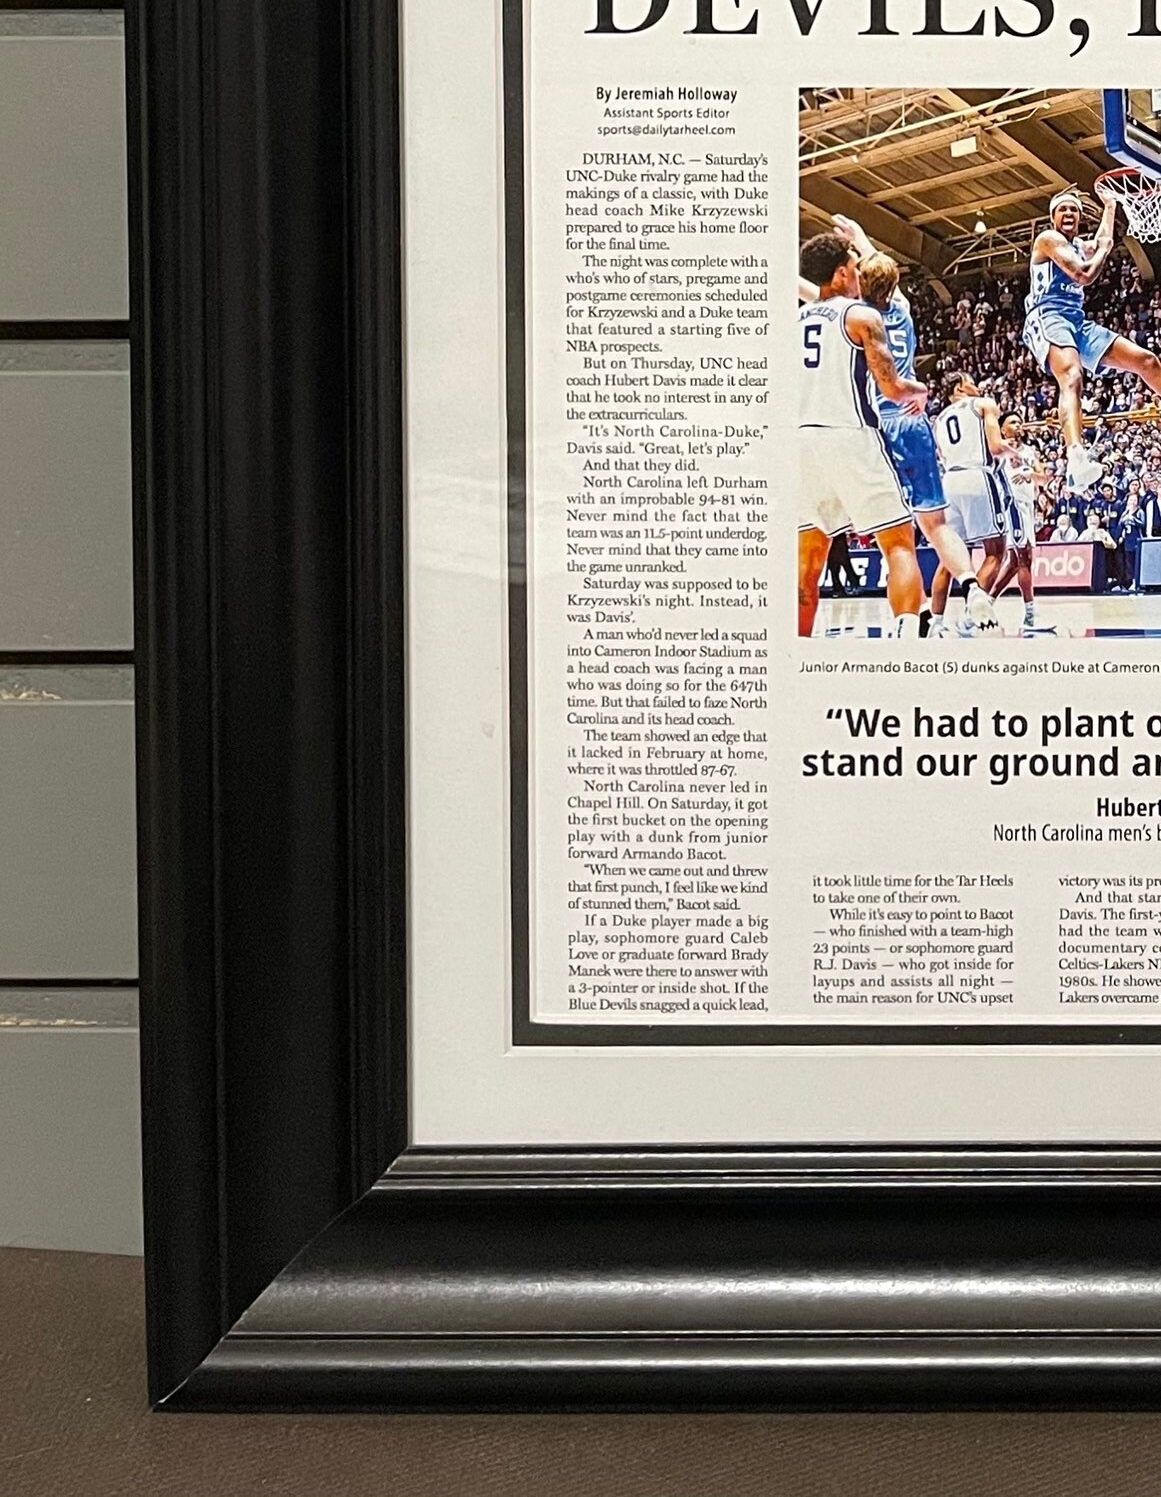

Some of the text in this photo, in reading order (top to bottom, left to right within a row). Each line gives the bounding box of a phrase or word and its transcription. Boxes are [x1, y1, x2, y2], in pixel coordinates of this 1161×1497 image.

[596, 86, 737, 104] By Jeremiah Holloway
[604, 107, 730, 121] Assistant Sports Editor
[598, 124, 735, 137] sports@dailytarheel.com
[565, 203, 768, 219] head coach Mike Krzyzewski
[566, 340, 662, 356] NBA prospects.
[804, 324, 822, 368] 5
[946, 415, 961, 445] 0
[583, 475, 768, 488] North Carolina left Durham
[799, 661, 838, 674] Junior
[841, 661, 901, 674] Armando
[904, 661, 939, 674] Bacot
[943, 661, 958, 675] (5)
[961, 661, 1000, 674] dunks
[1003, 661, 1048, 676] against
[1052, 661, 1085, 674] Duke
[1088, 663, 1100, 674] at
[1103, 661, 1160, 674] Cameron
[827, 709, 900, 737] “We
[915, 707, 978, 737] had
[992, 711, 1027, 737] to
[1042, 707, 1133, 746] plant
[803, 747, 902, 776] stand
[917, 755, 977, 776] our
[990, 746, 1118, 785] ground
[994, 824, 1036, 841] North
[1042, 824, 1102, 841] Carolina
[1109, 824, 1151, 841] men’s
[568, 930, 768, 947] play, sophomore guard Caleb
[1058, 940, 1147, 957] documentary
[813, 974, 995, 990] layups and assists all night
